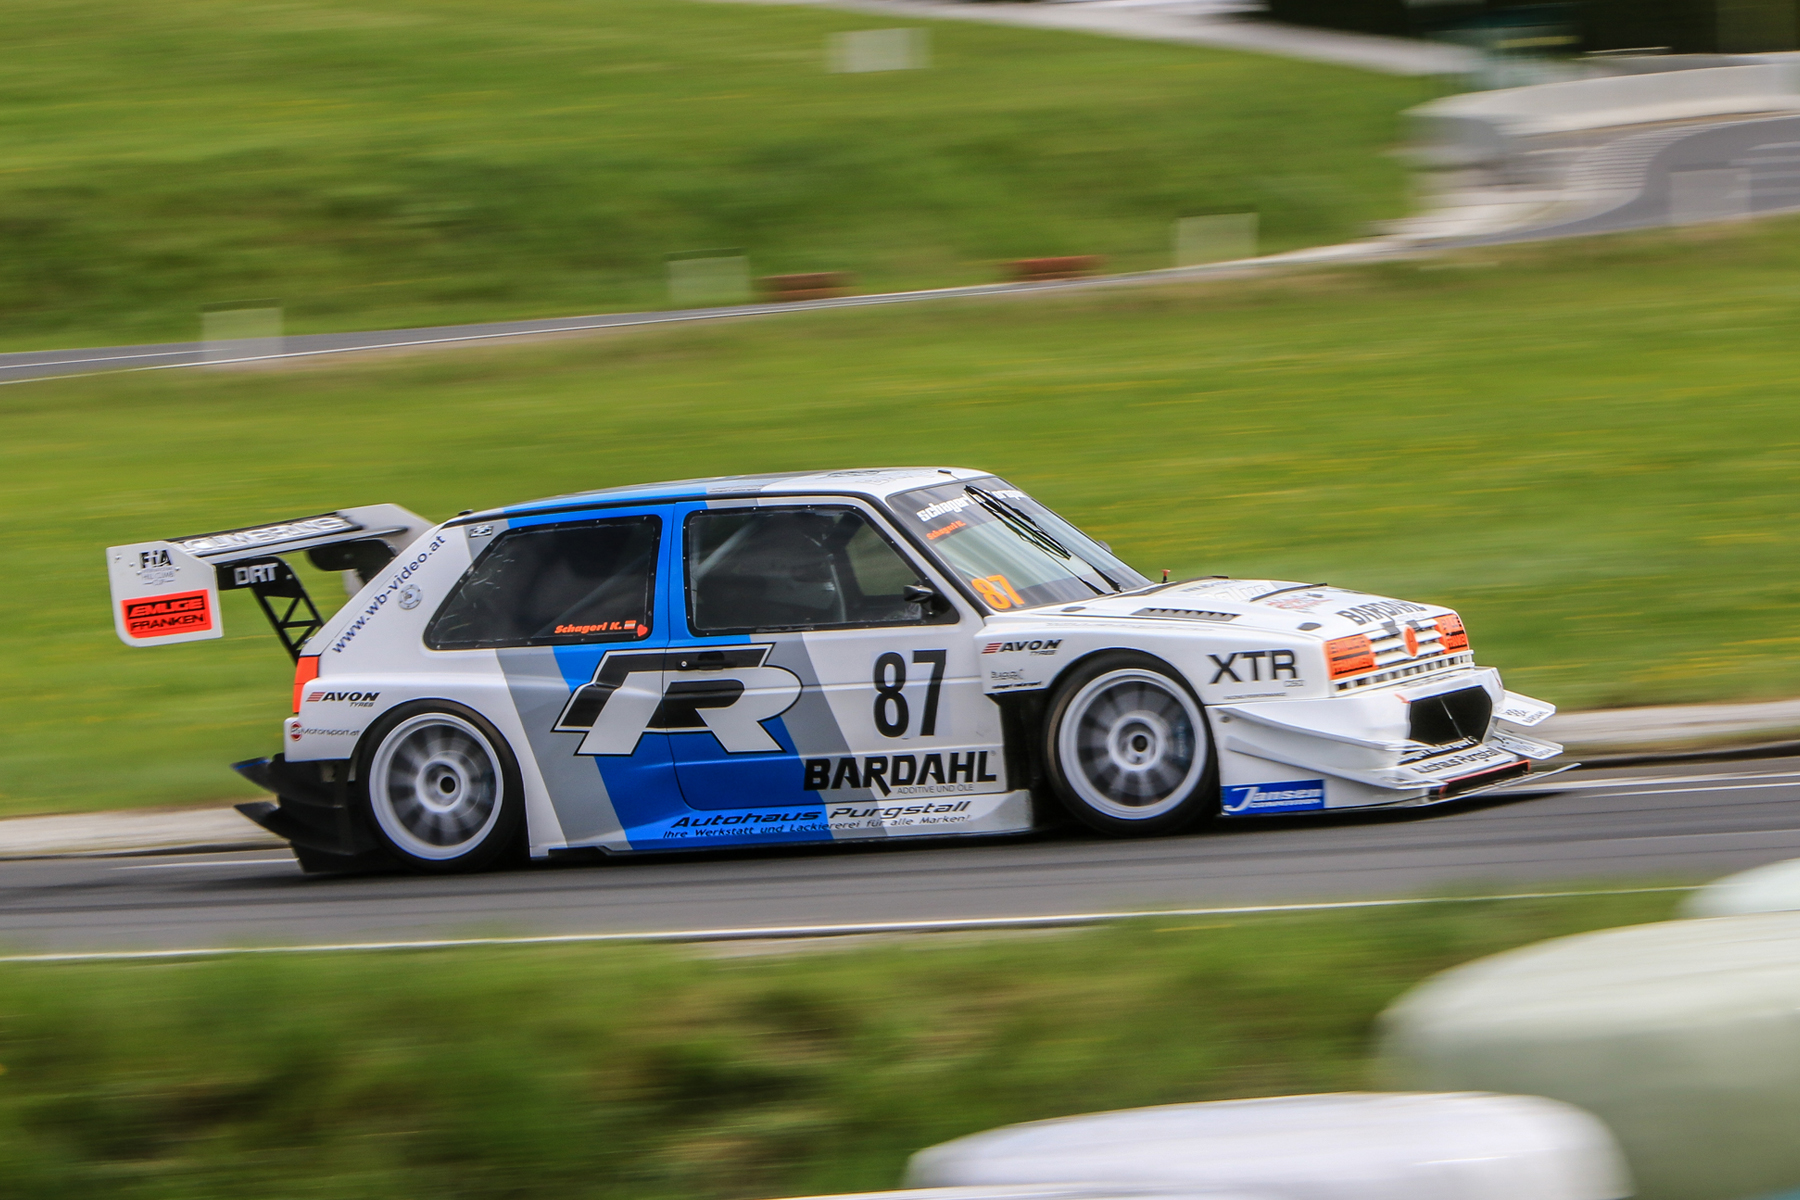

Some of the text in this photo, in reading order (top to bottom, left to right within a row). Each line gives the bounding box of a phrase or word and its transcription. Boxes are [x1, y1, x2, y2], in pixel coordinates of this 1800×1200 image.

[234, 562, 279, 586] DRT
[332, 535, 446, 653] www.wb-video.at
[971, 574, 1025, 609] 87
[130, 614, 204, 631] FRANKEN
[1335, 600, 1428, 626] BARDAHL
[554, 621, 622, 634] Schagerl K.
[998, 639, 1063, 652] AVON
[1206, 649, 1298, 685] XTR
[321, 691, 381, 702] AVON
[872, 649, 947, 739] 87
[803, 751, 997, 797] BARDAHL
[897, 785, 934, 794] ADDITIVE
[937, 784, 955, 793] UND
[1223, 786, 1323, 812] Jansen
[663, 814, 972, 839] Ihre Werkstatt und Lackiererei für alle Marken!
[670, 801, 972, 829] Autohaus Purgstall
